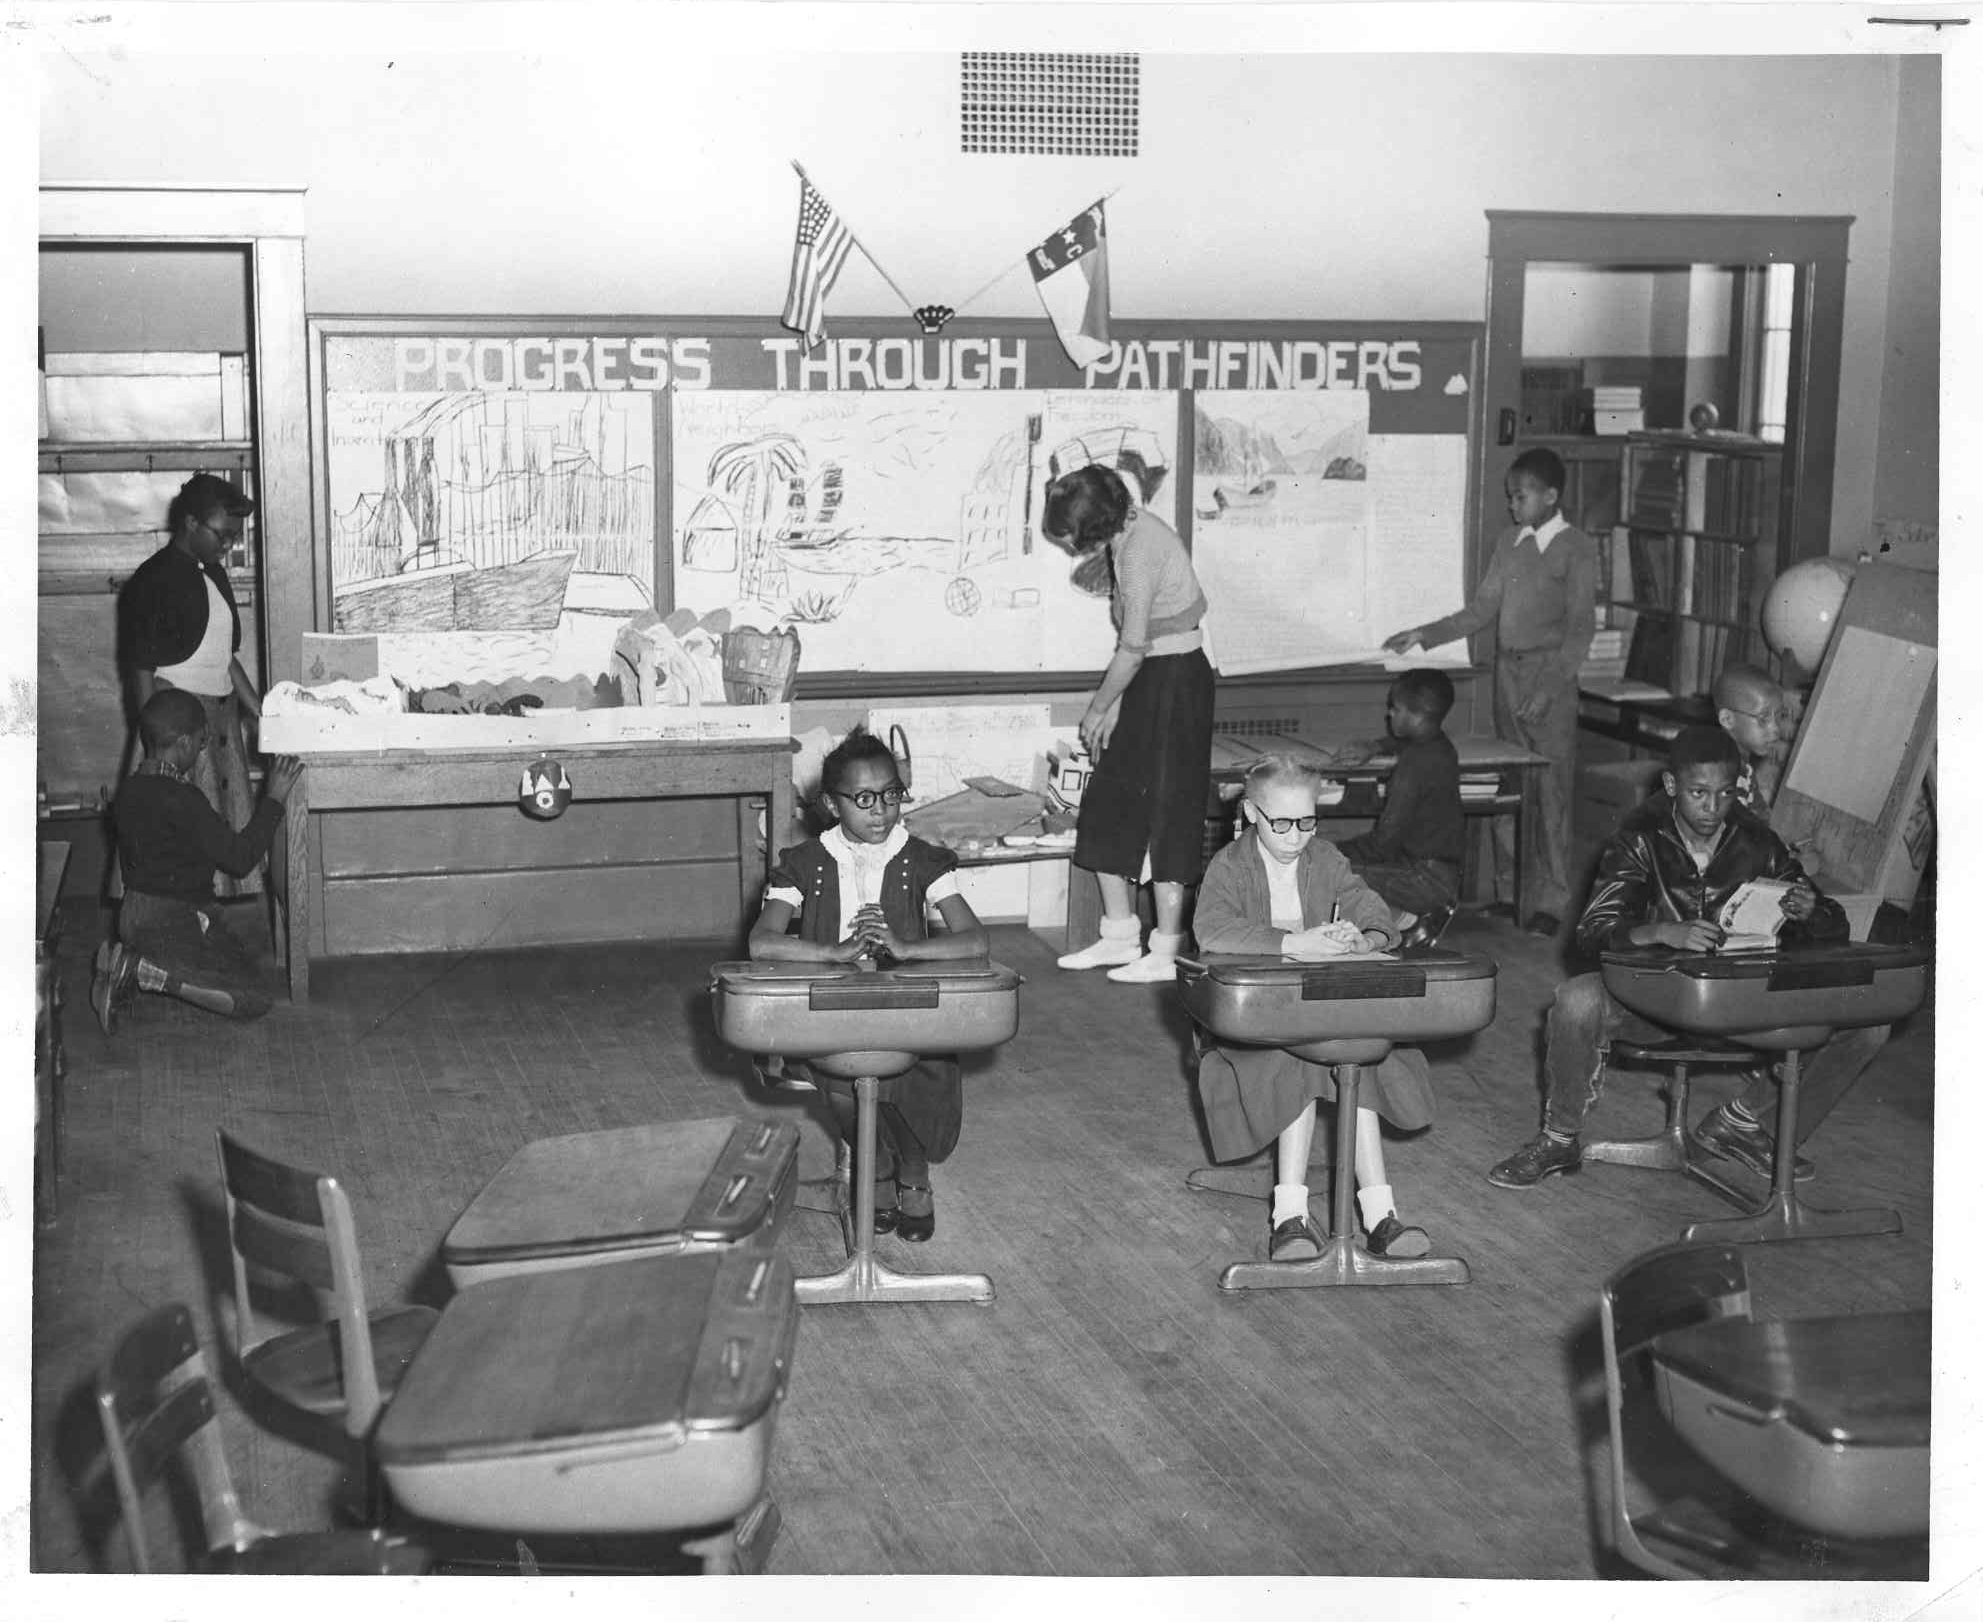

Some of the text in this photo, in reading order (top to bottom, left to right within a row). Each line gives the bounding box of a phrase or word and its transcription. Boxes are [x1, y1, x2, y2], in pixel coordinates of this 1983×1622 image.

[396, 337, 1421, 390] PROGRESS THROUGH PATHFINDERS
